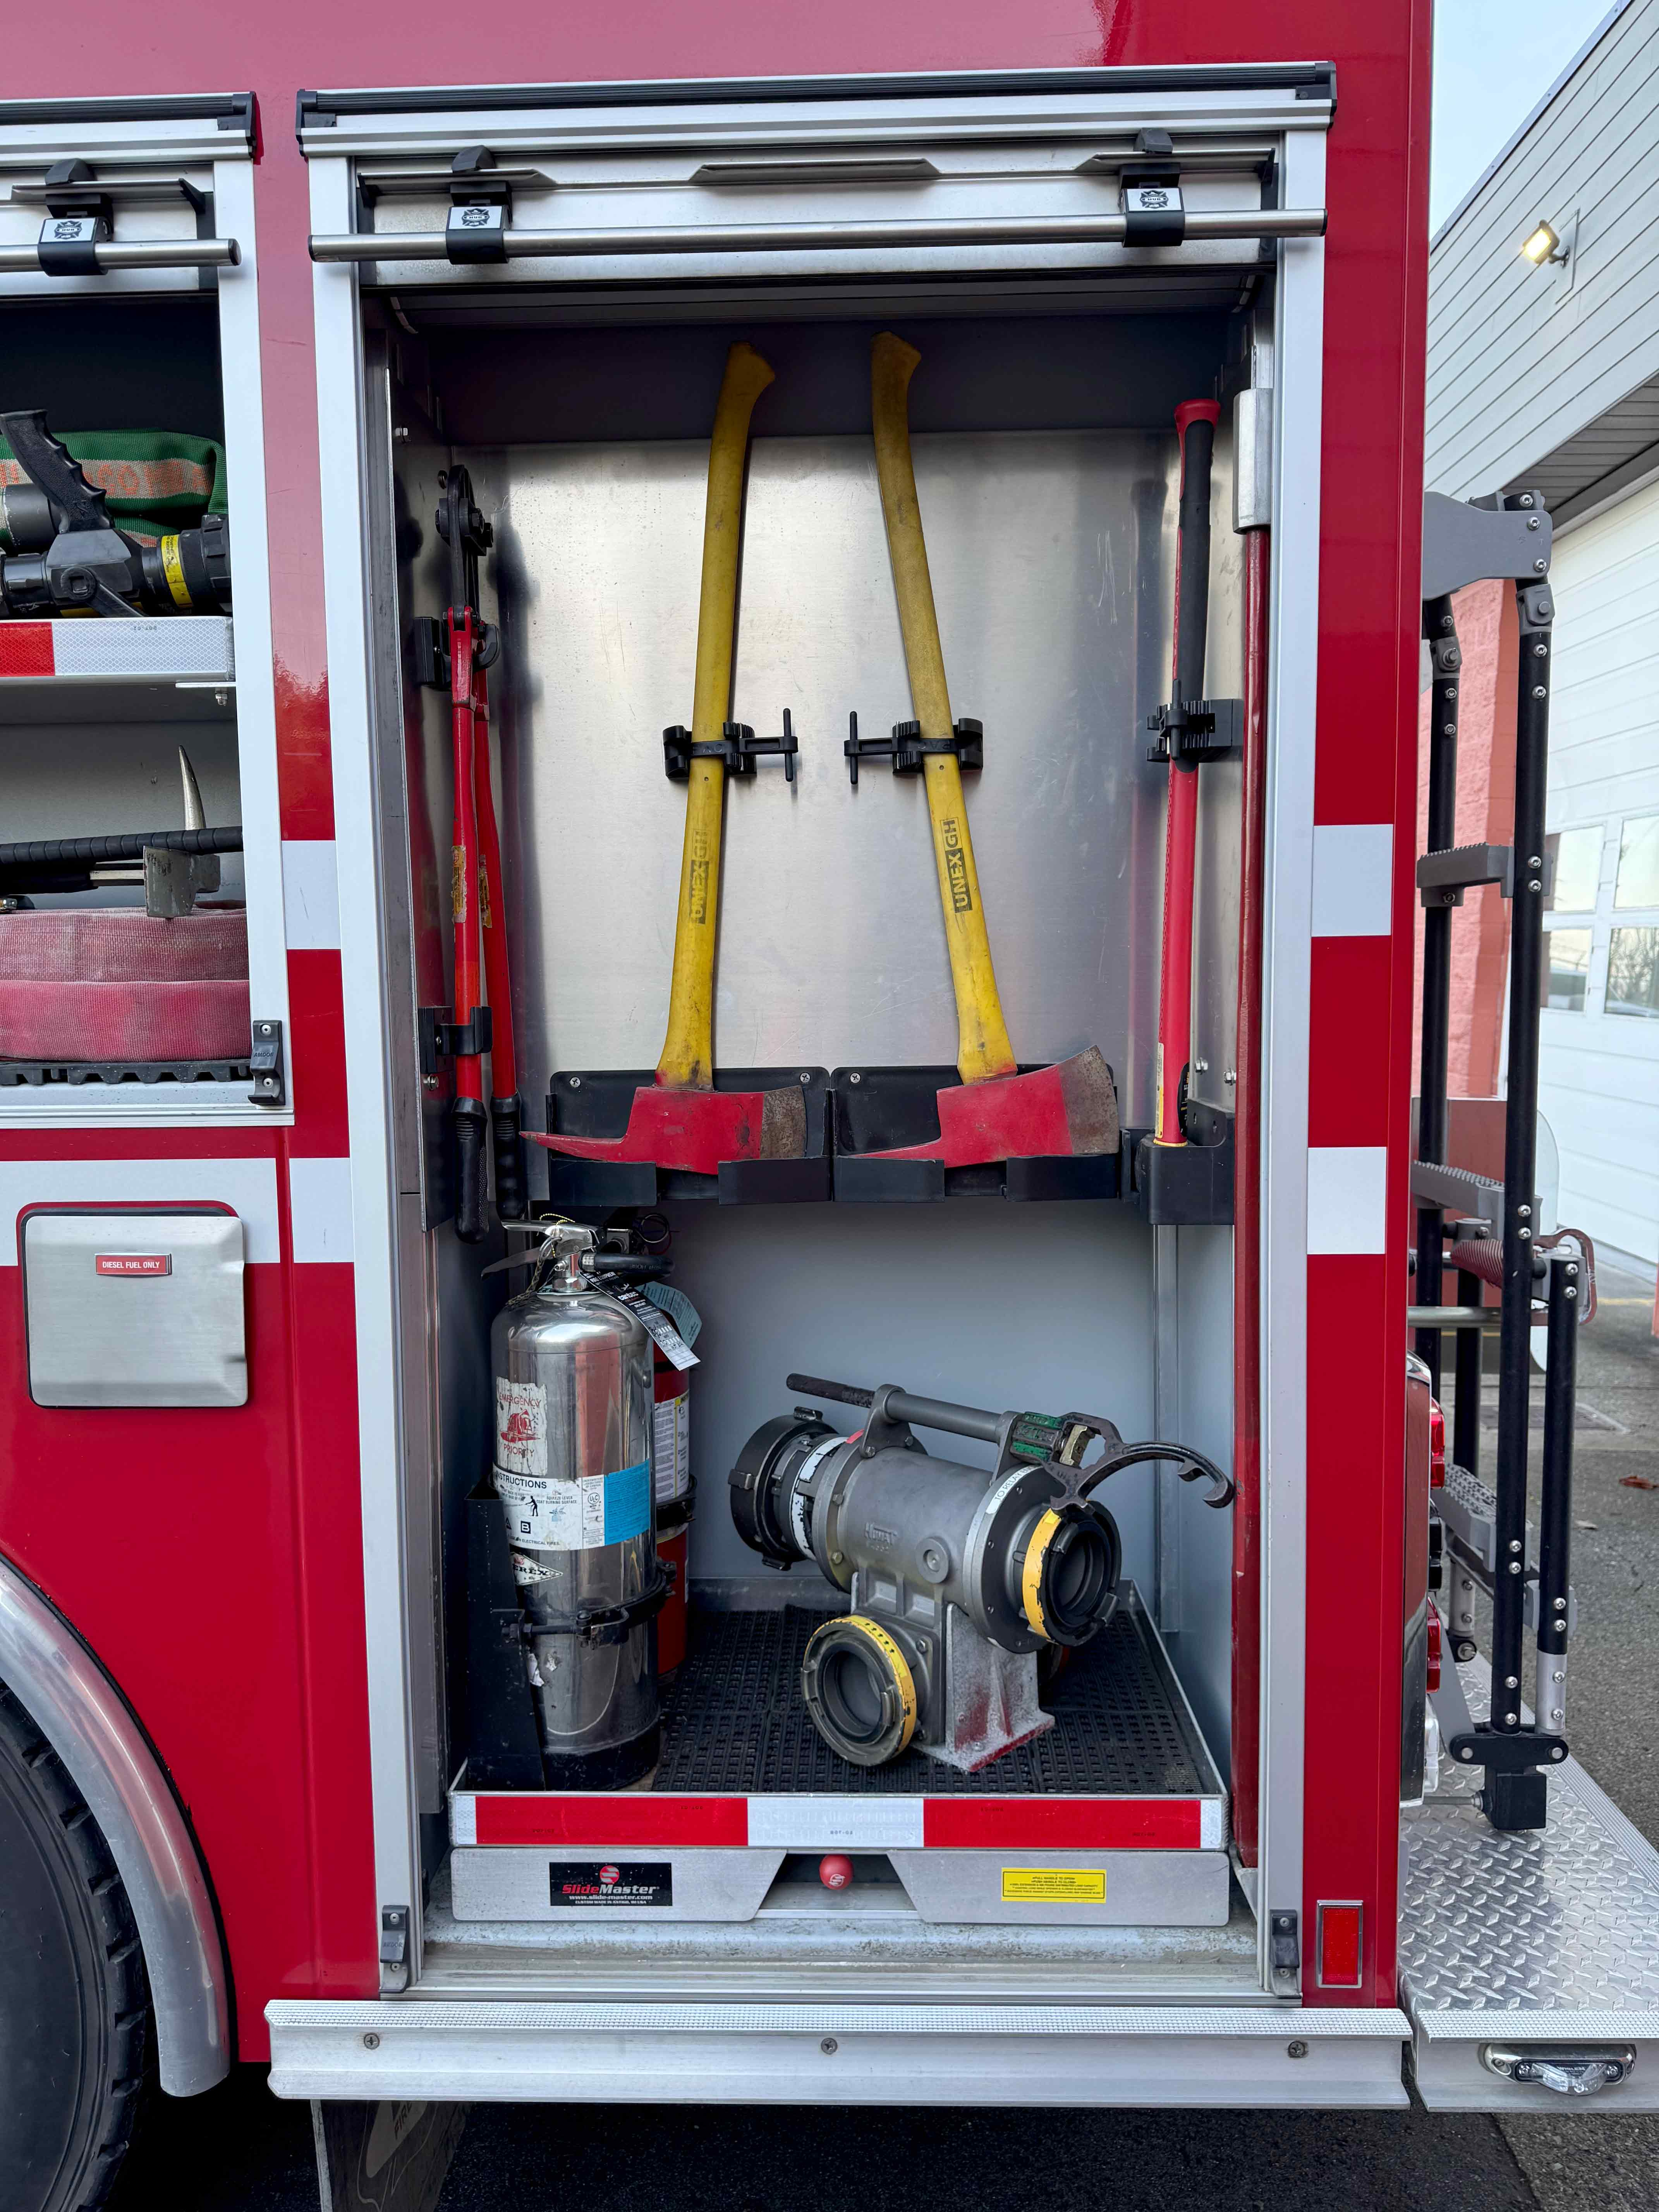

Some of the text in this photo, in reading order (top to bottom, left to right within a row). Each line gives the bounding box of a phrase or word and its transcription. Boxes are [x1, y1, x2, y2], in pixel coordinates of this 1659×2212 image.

[948, 852, 968, 908] UNEX
[499, 1394, 541, 1407] EMERGENCY
[503, 1443, 535, 1457] PRIORTY
[994, 1472, 1022, 1500] TO RELAY
[589, 1494, 598, 1503] ULC
[522, 1523, 530, 1534] B
[512, 1563, 549, 1576] EREX
